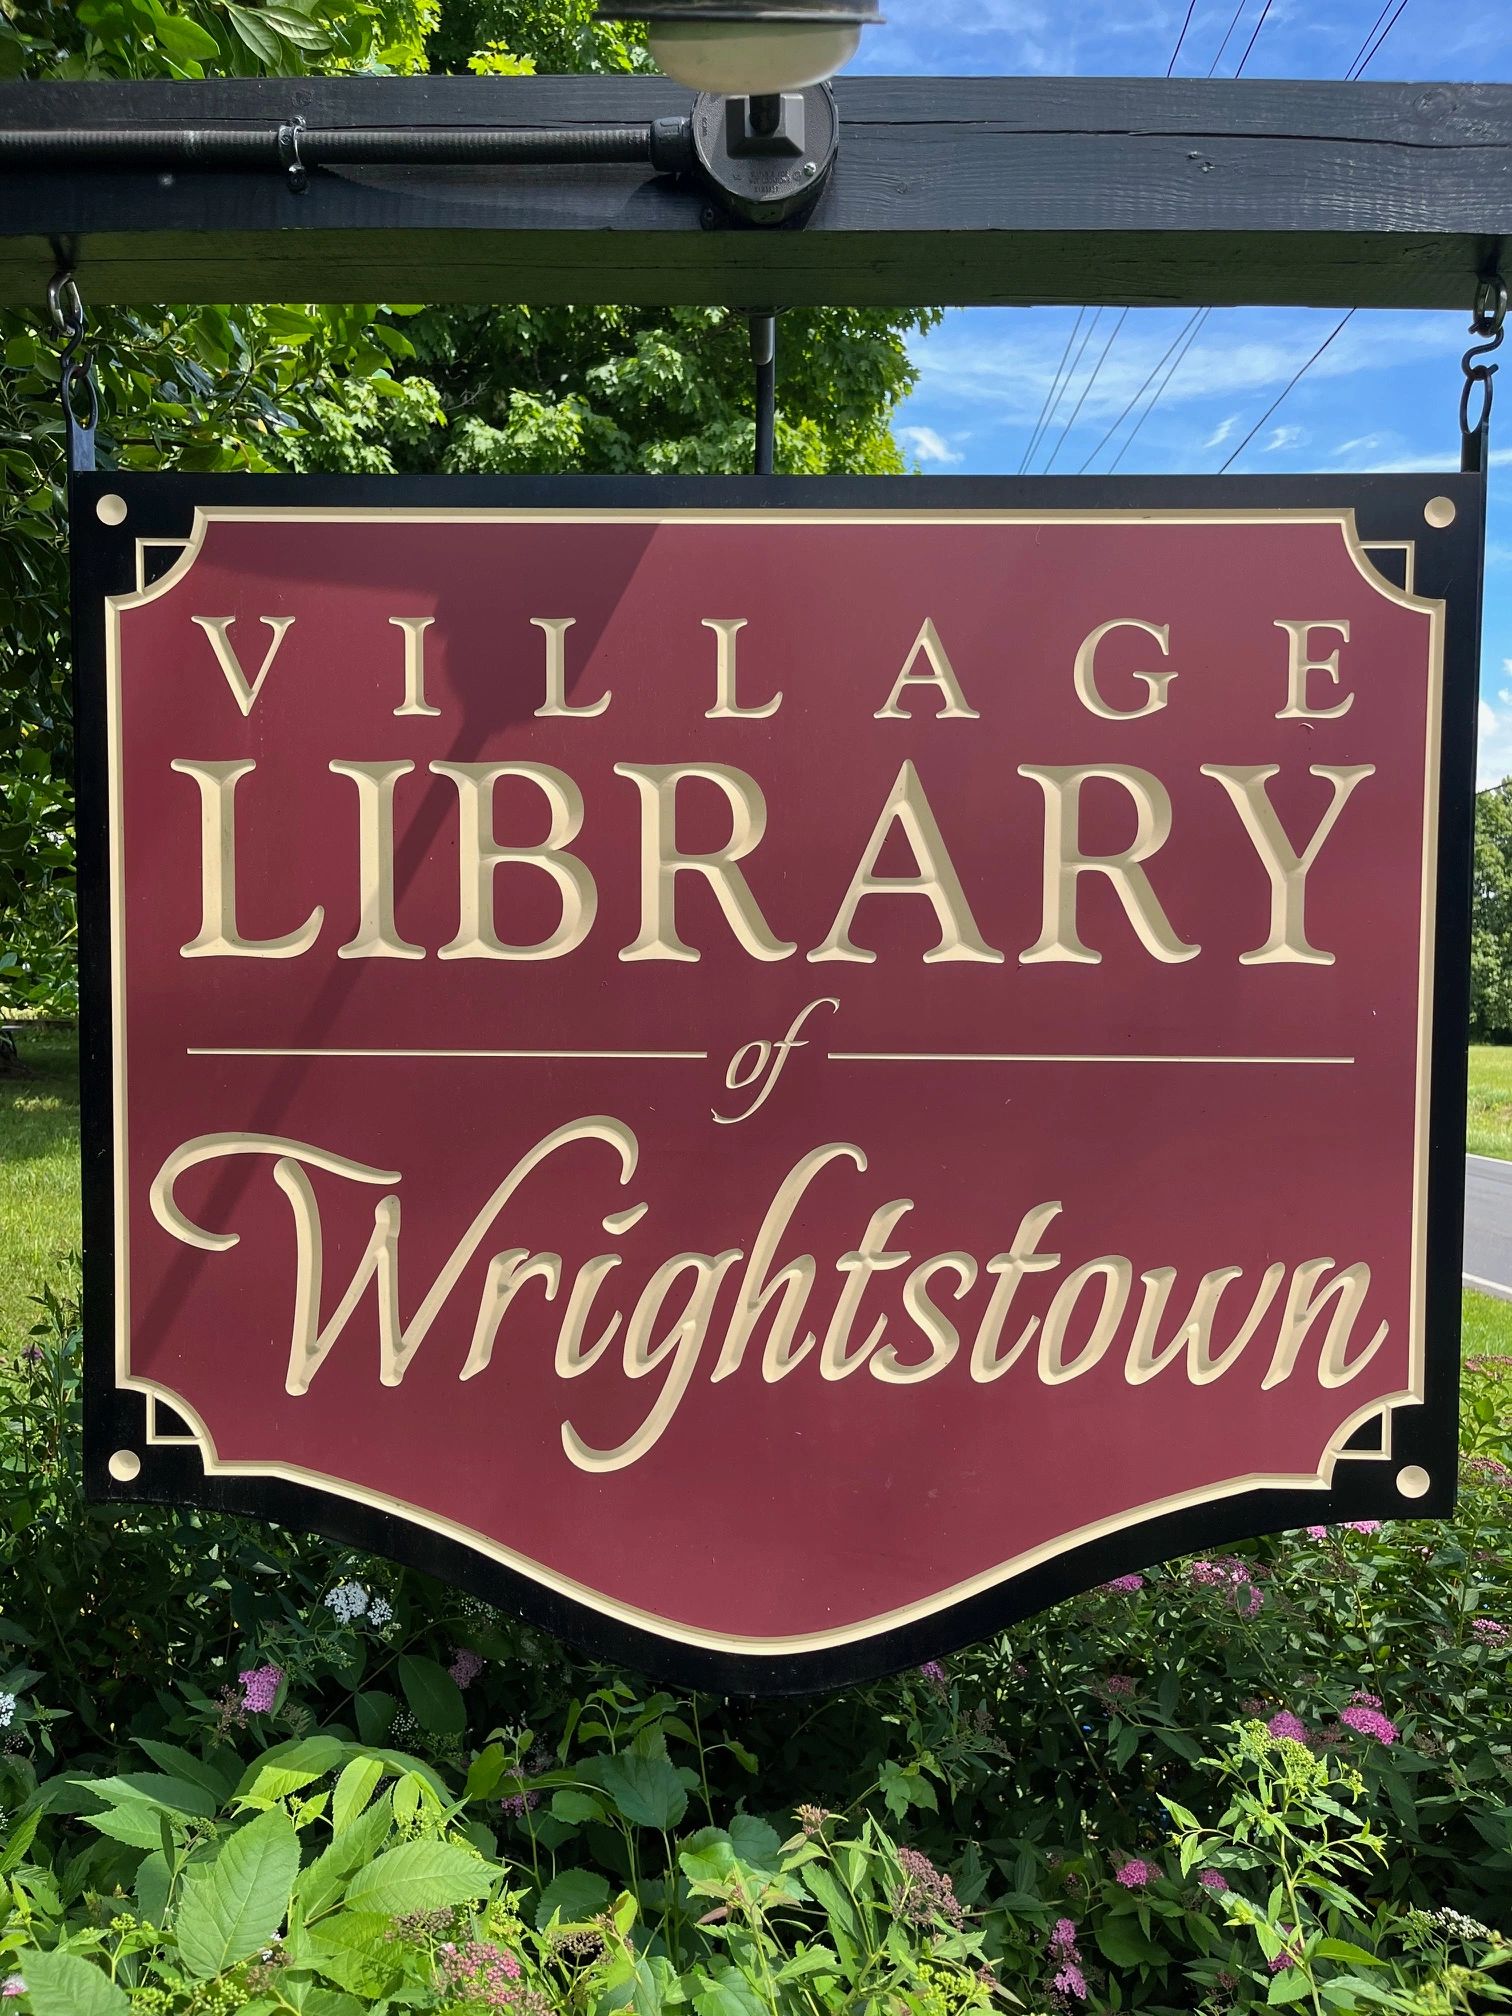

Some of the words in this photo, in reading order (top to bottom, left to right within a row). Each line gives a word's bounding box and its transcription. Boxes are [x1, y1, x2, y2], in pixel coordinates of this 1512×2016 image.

[190, 615, 1356, 722] VILLAGE
[170, 758, 1377, 967] LIBRARY
[710, 996, 841, 1125] of
[148, 1114, 1391, 1476] Wrightstown
